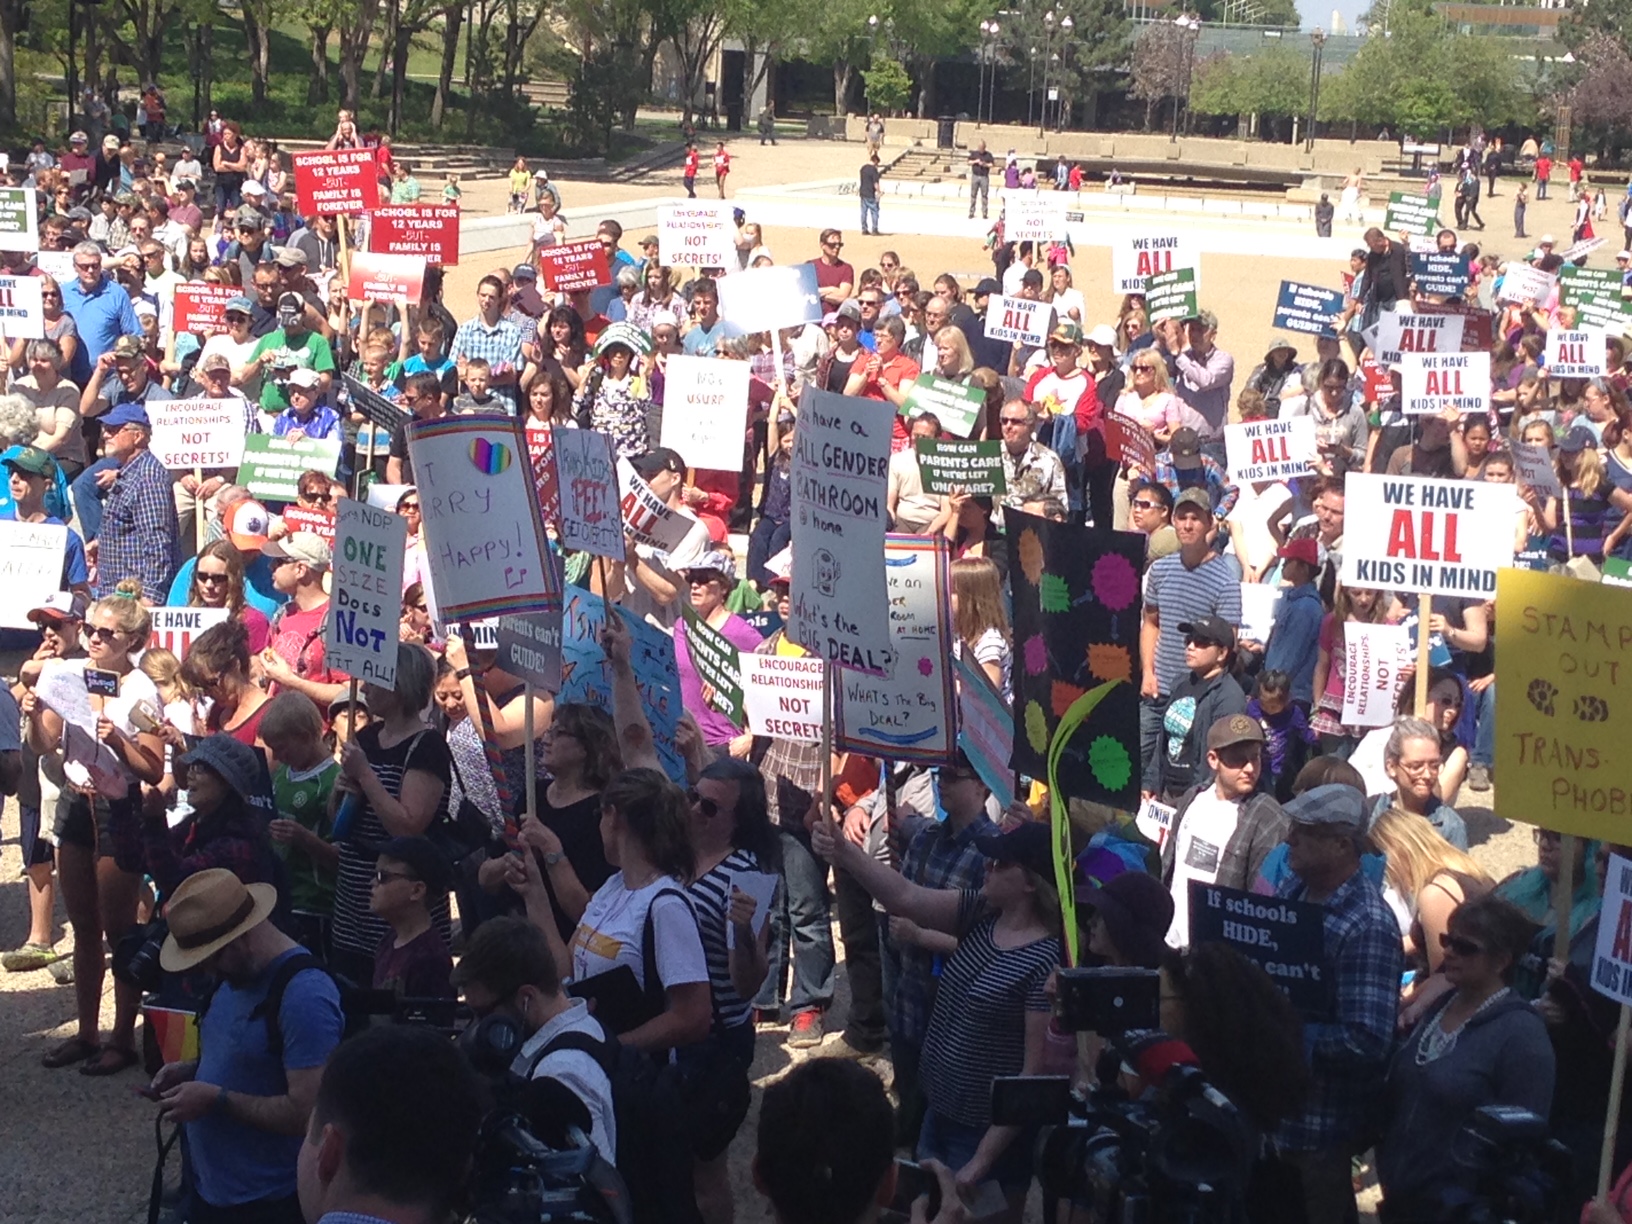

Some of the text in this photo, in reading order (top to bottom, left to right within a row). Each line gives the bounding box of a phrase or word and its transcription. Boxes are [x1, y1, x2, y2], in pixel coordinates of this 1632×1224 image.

[296, 152, 372, 166] SCHOOL IS FOR
[312, 165, 360, 177] 12 YEARS
[313, 189, 362, 200] FAMILY IS
[317, 200, 363, 212] FOREVER
[374, 208, 457, 218] SCHOOL IS FOR
[391, 220, 443, 229] 12 YEARS
[389, 242, 441, 251] FAMILY IS
[584, 242, 602, 251] FOR
[685, 236, 708, 247] NOT
[1132, 237, 1178, 249] WE HAVE
[564, 253, 593, 264] YEARS
[1137, 251, 1173, 276] ALL
[554, 272, 585, 283] FAMILY
[559, 278, 598, 290] FOREVER
[1121, 279, 1146, 290] KIDS
[7, 309, 28, 318] MIND
[1003, 299, 1037, 312] WE HAVE
[1002, 310, 1031, 332] ALL
[1399, 316, 1446, 328] WE HAVE
[990, 327, 1008, 339] KIDS
[1400, 329, 1436, 352] ALL
[1382, 351, 1402, 363] KID
[1558, 343, 1586, 363] ALL
[1422, 356, 1468, 368] WE HAVE
[1426, 370, 1464, 395] ALL
[1410, 398, 1435, 409] KIDS
[1453, 397, 1481, 409] MIND
[813, 400, 841, 430] have
[850, 421, 869, 437] a
[1245, 421, 1292, 437] WE HAVE
[181, 432, 211, 444] NOT
[796, 432, 888, 479] ALL GENDER
[958, 444, 977, 453] CAN
[1251, 436, 1291, 464] ALL
[165, 452, 229, 465] SECRETS!
[920, 454, 1001, 468] PARENTS CARE
[1237, 462, 1310, 480] KIDS IN MIND
[629, 475, 672, 521] WE HAVE
[1383, 482, 1475, 510] WE HAVE
[621, 492, 659, 535] ALL
[316, 525, 336, 537] YEA
[1387, 509, 1462, 563] ALL
[343, 535, 387, 572] ONE
[338, 565, 388, 596] SIZE
[905, 578, 921, 588] an
[1357, 560, 1496, 592] KIDS IN MIND
[165, 612, 201, 628] HAVE
[834, 612, 860, 636] the
[1521, 605, 1632, 650] STAMP
[473, 627, 499, 644] MIN
[501, 615, 560, 648] parents can't
[912, 626, 936, 635] HOME
[715, 637, 732, 656] CAN
[510, 643, 545, 673] GUIDE!
[828, 638, 892, 674] DEAL?
[759, 658, 823, 674] ENCOURAGE
[1346, 641, 1357, 704] ENCOURAGE
[1376, 658, 1390, 690] NOT
[1558, 652, 1620, 686] OUT
[751, 674, 823, 691] RELATIONSHIP
[848, 683, 889, 706] WHAT'S
[779, 697, 810, 714] NOT
[1207, 889, 1298, 925] If schools
[1223, 920, 1279, 951] HIDE,
[1265, 960, 1321, 982] can't
[1595, 956, 1621, 993] KIDS
